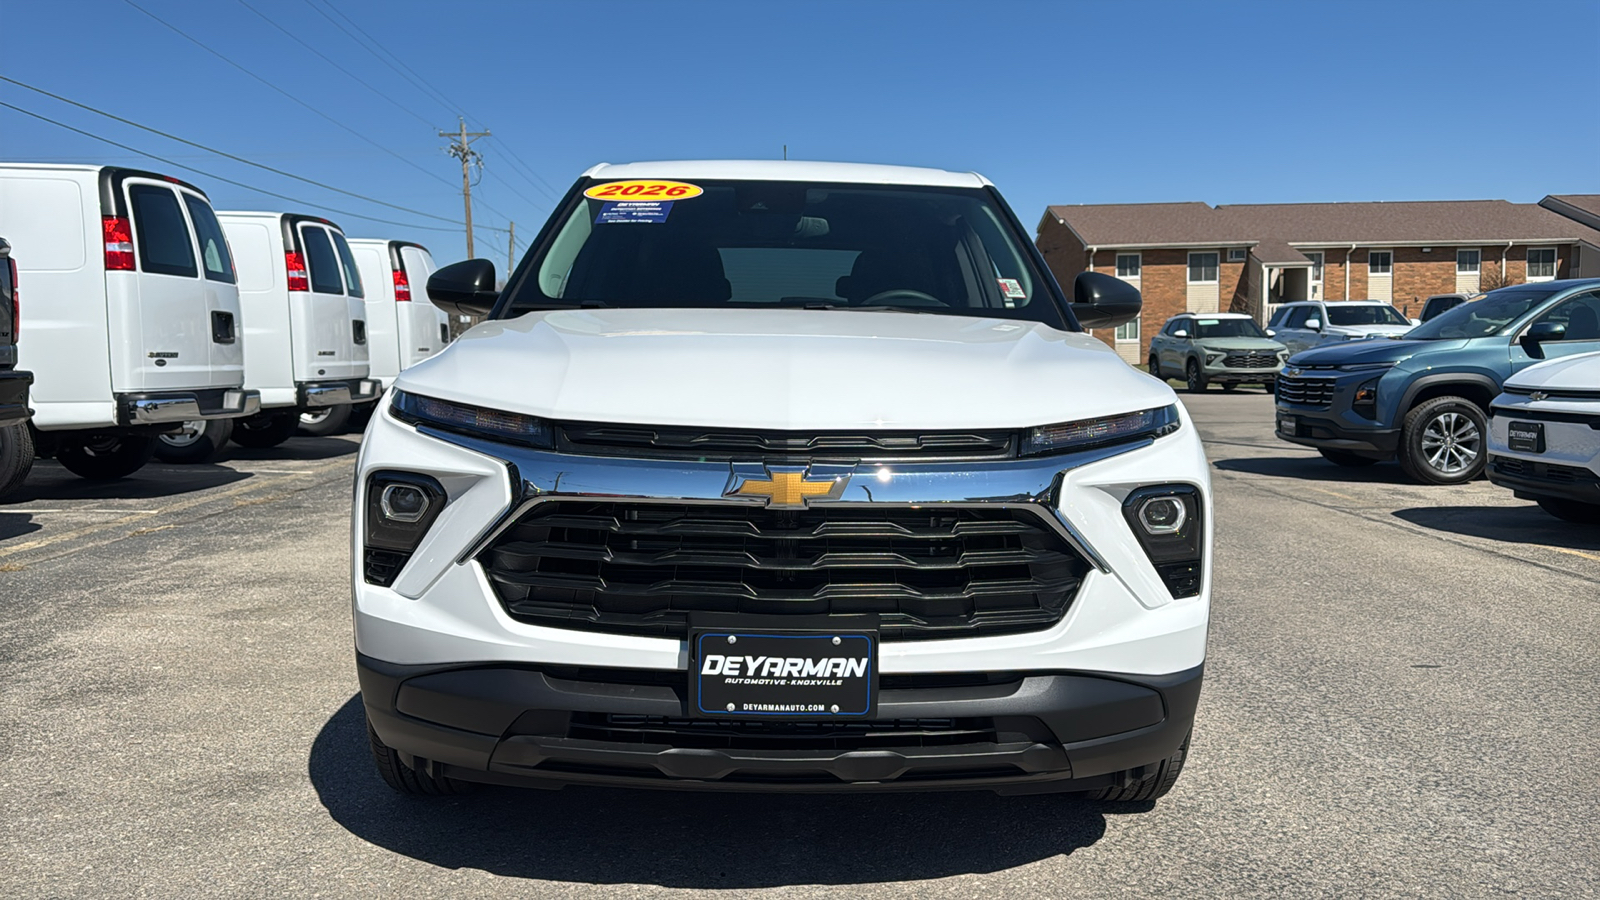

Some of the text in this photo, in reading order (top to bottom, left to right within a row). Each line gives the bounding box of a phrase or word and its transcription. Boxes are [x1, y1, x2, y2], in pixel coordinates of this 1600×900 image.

[595, 185, 691, 197] 2026
[1509, 430, 1538, 439] DEYARMAN
[701, 654, 868, 678] DEYARMAN
[743, 703, 825, 712] DEYARMANAUTO.COM
